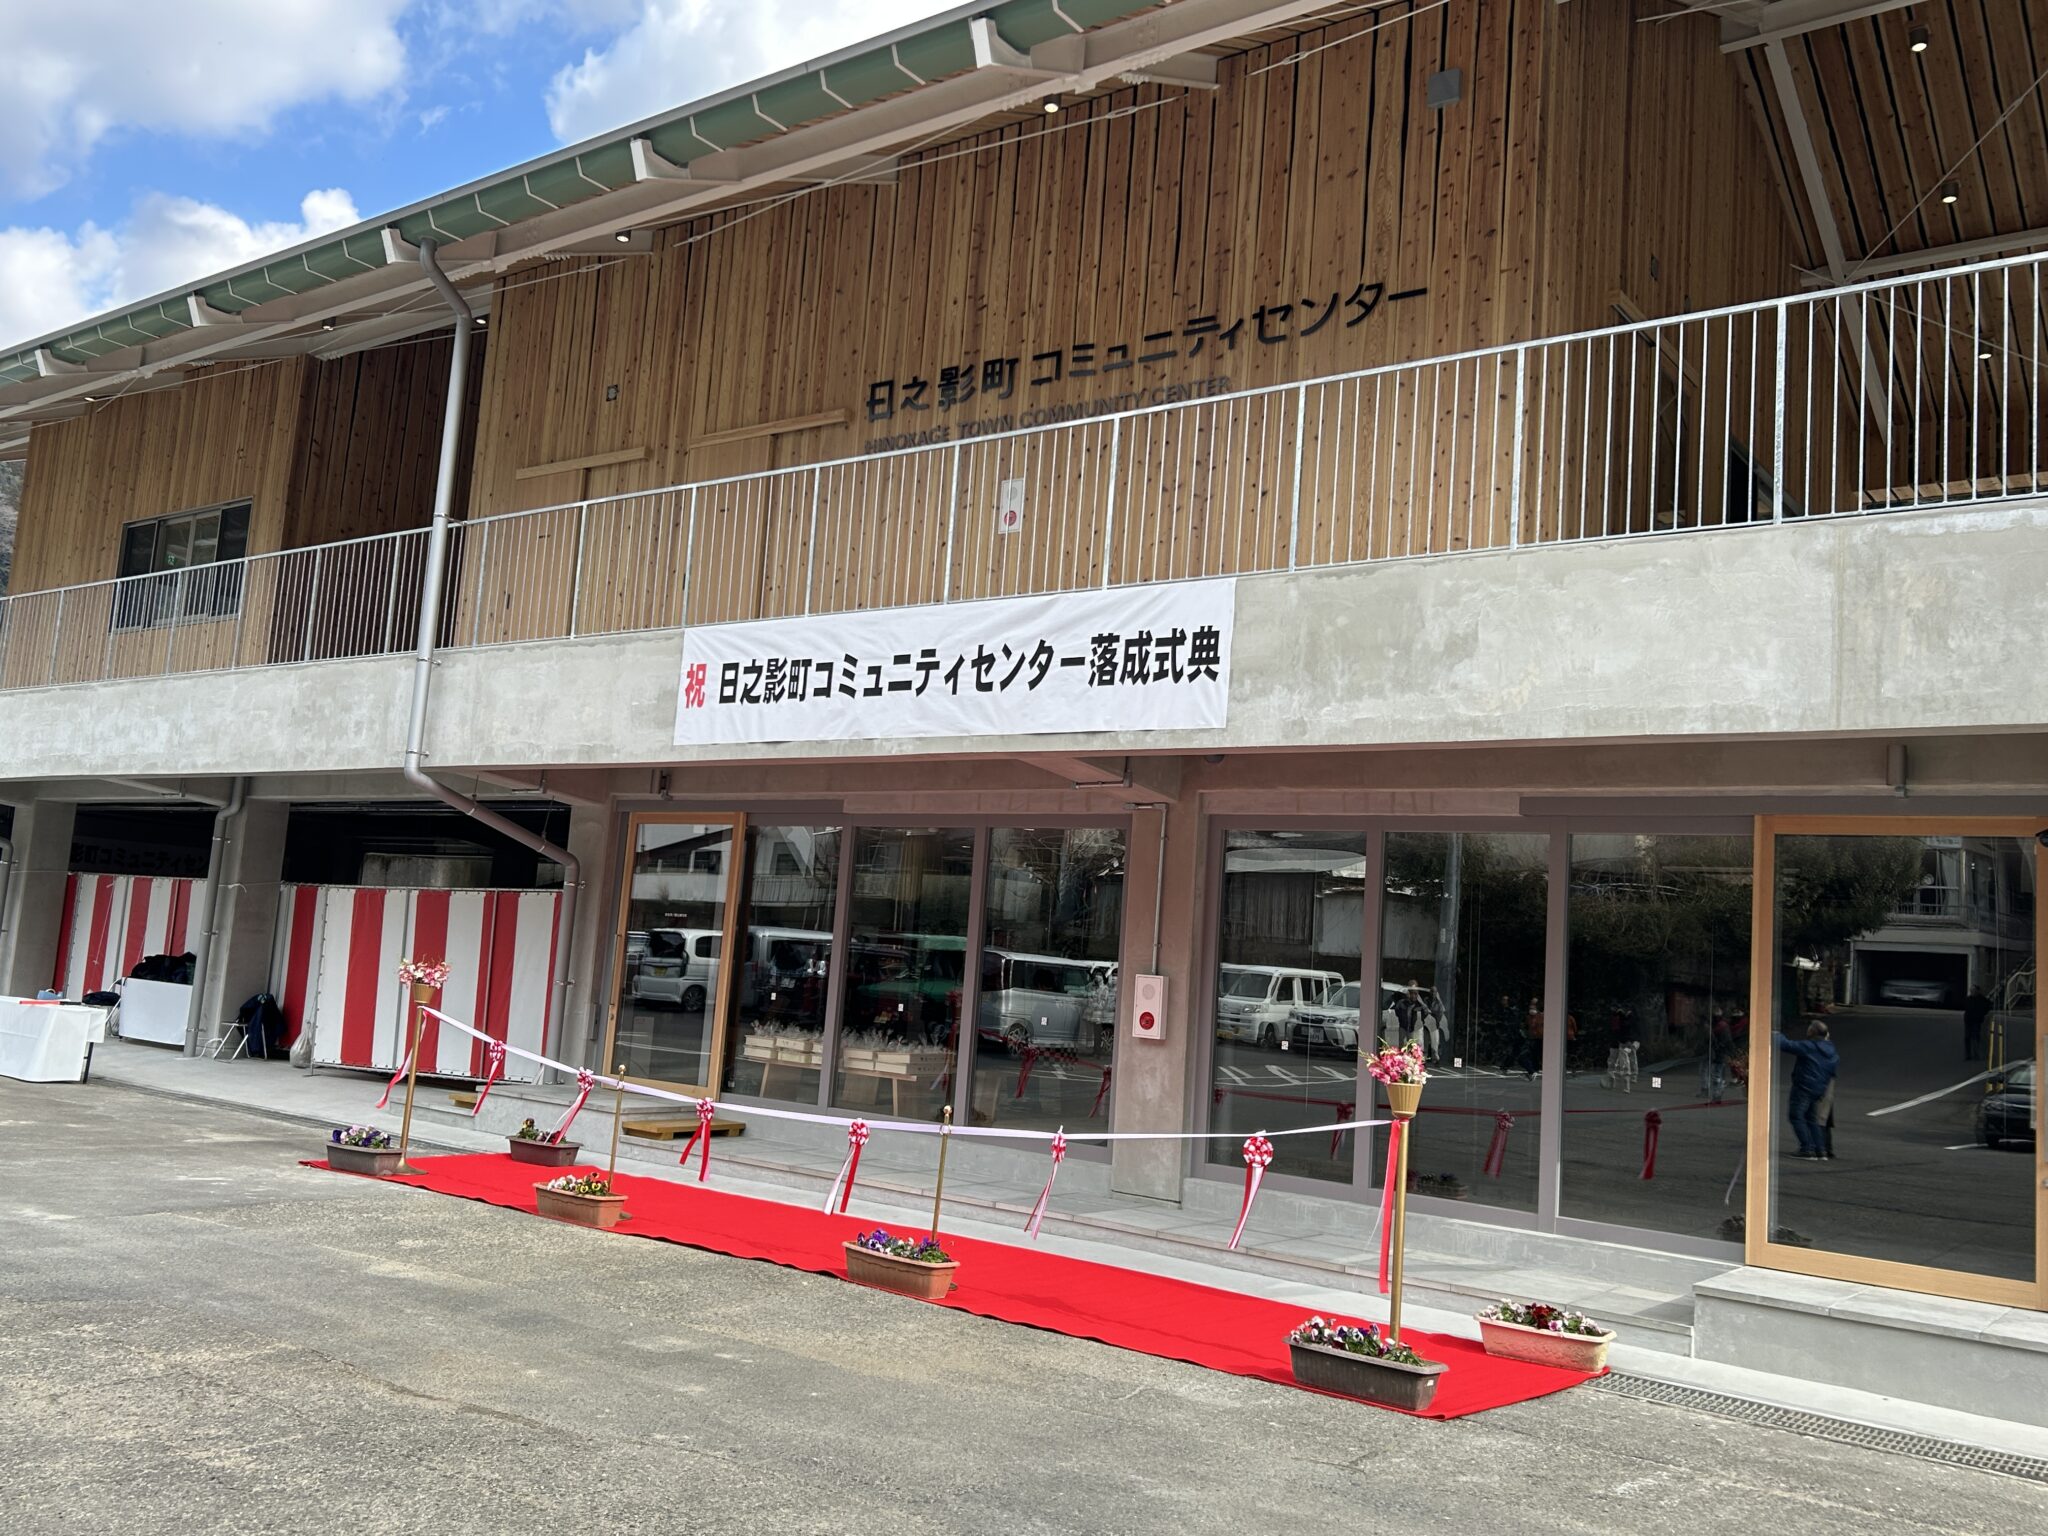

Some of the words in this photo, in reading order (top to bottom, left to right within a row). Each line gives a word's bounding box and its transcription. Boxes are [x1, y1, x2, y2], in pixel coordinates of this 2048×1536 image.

[865, 425, 950, 453] HINOKAGE
[958, 415, 1014, 438] TOWN
[1020, 391, 1144, 429] COMMUNITY
[1151, 374, 1233, 407] CENTER
[684, 662, 707, 709] 祝
[718, 624, 1222, 704] 日之影町コミュニティセンター落成式典
